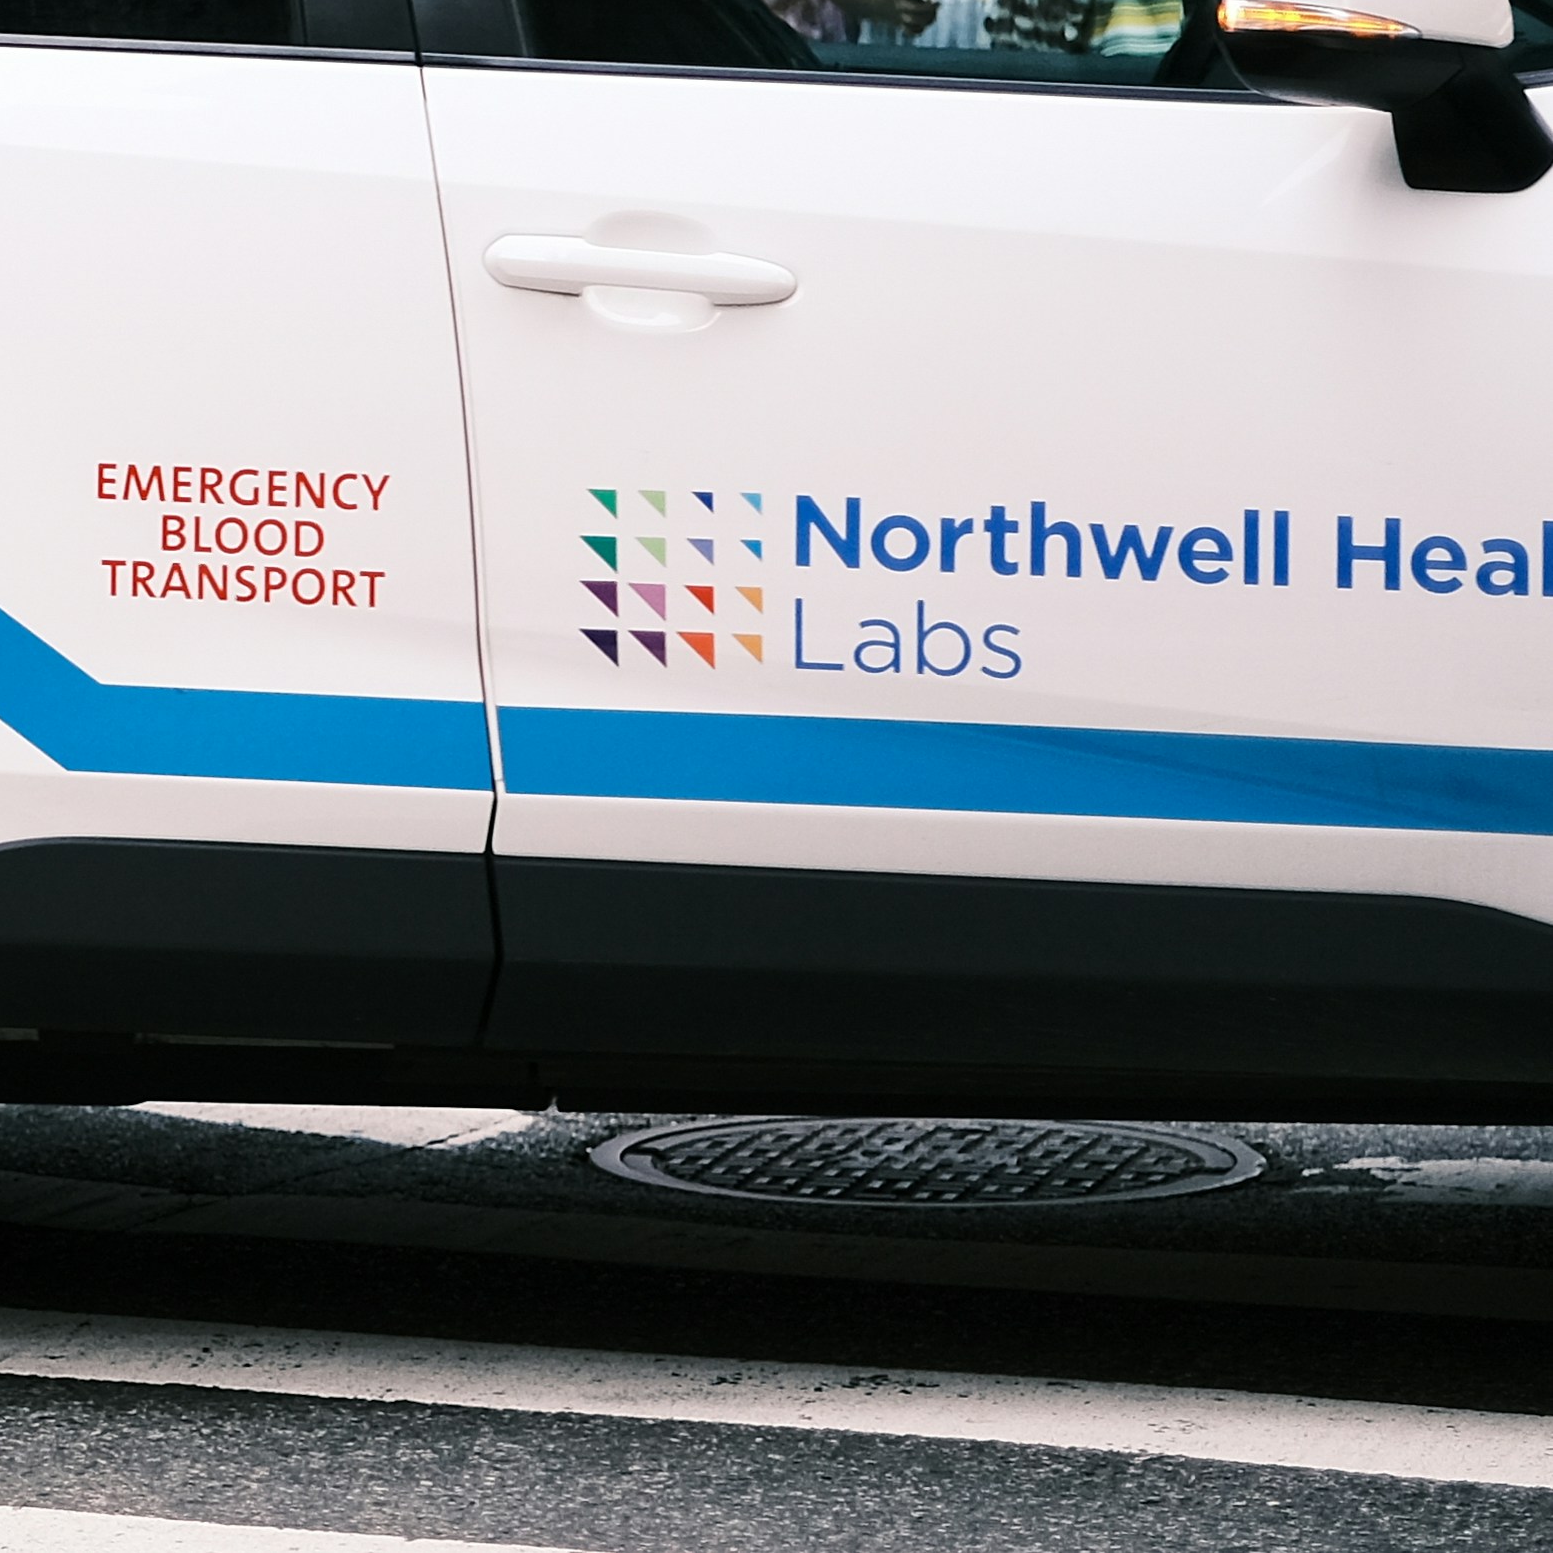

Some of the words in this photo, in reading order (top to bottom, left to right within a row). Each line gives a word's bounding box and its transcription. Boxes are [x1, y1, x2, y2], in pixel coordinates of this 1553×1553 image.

[96, 462, 391, 511] EMERGENCY
[160, 514, 325, 557] BLOOD
[794, 494, 1291, 587] Northwell
[100, 559, 386, 608] TRANSPORT
[794, 597, 1023, 680] Labs
